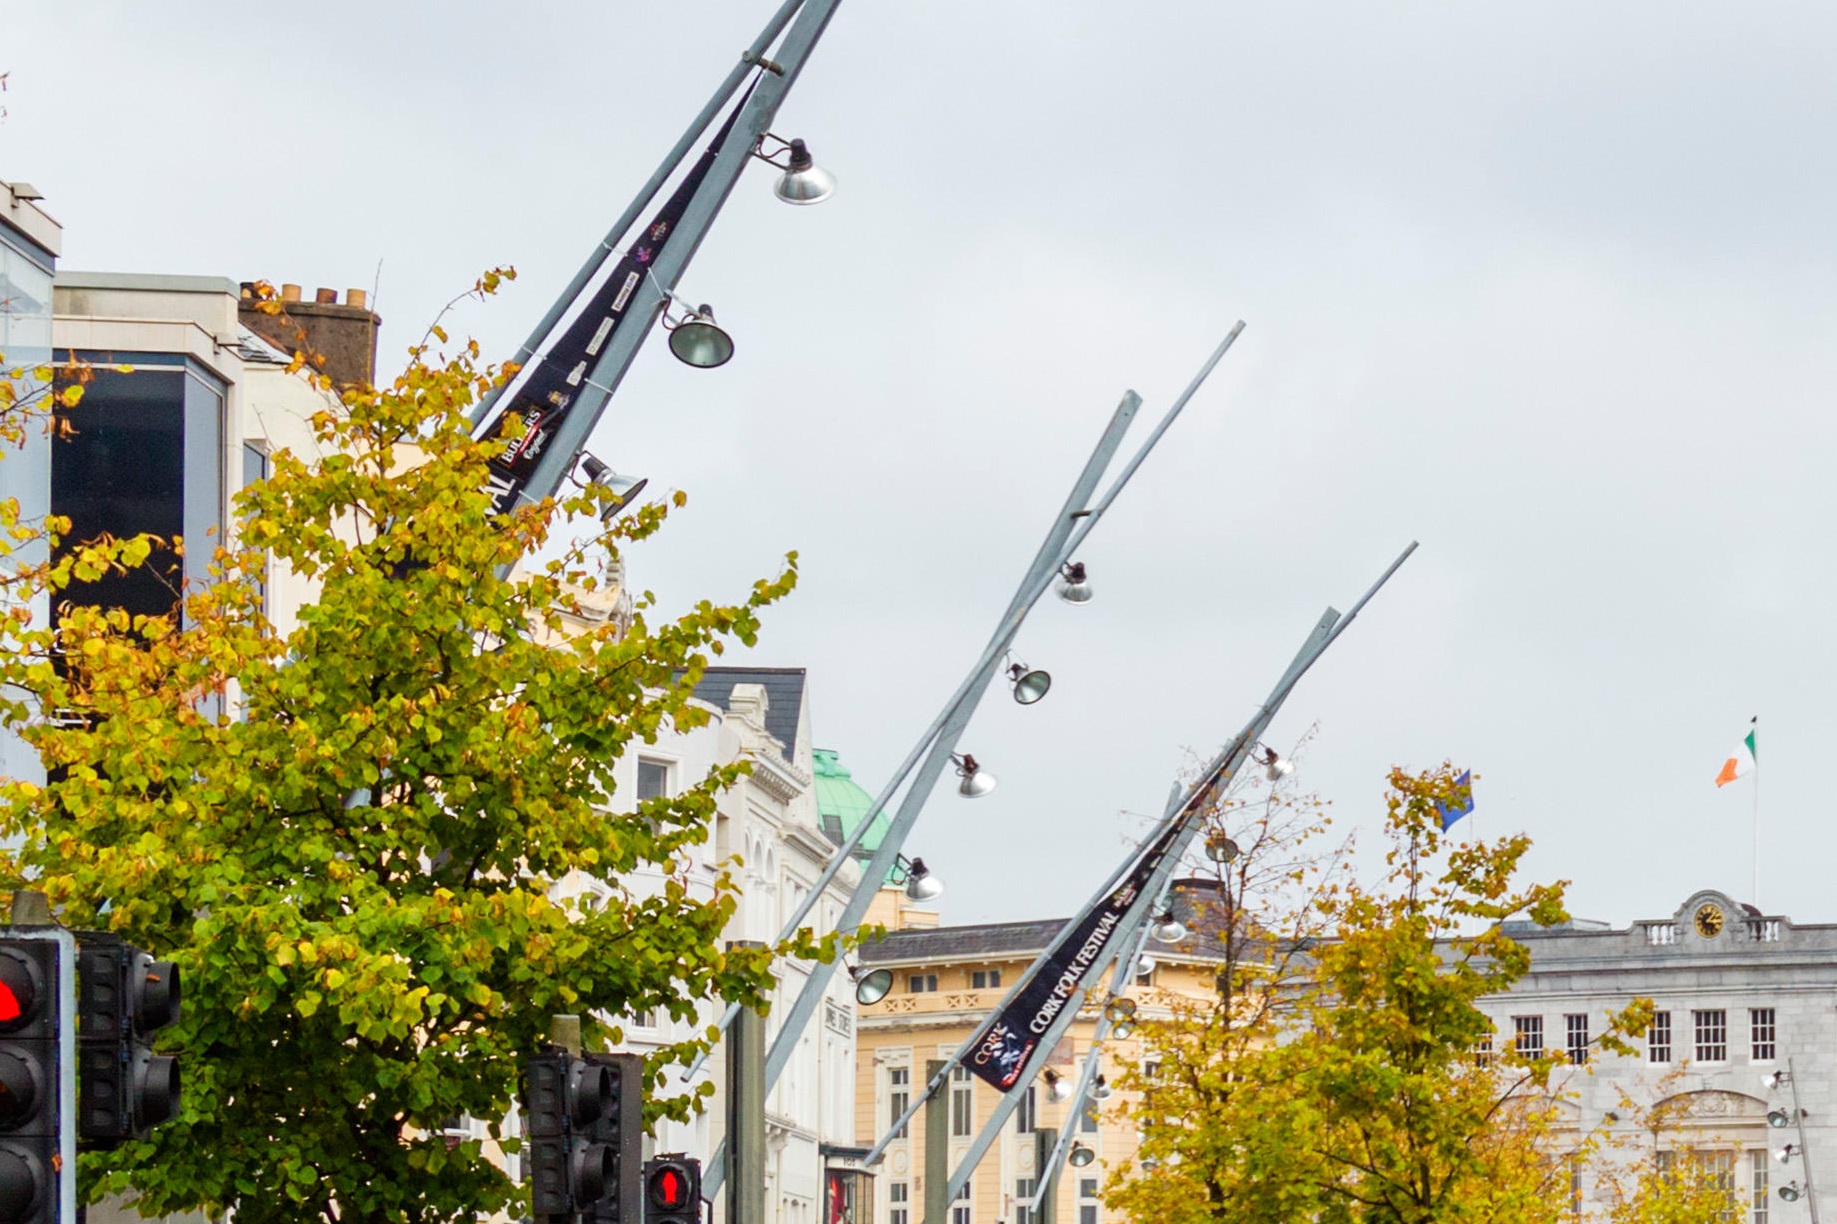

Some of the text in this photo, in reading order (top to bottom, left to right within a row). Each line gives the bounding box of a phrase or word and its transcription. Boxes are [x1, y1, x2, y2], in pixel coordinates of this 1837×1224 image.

[1077, 911, 1120, 964] FESTIVAL
[1056, 957, 1085, 999] FOLK
[1029, 991, 1063, 1034] CORK
